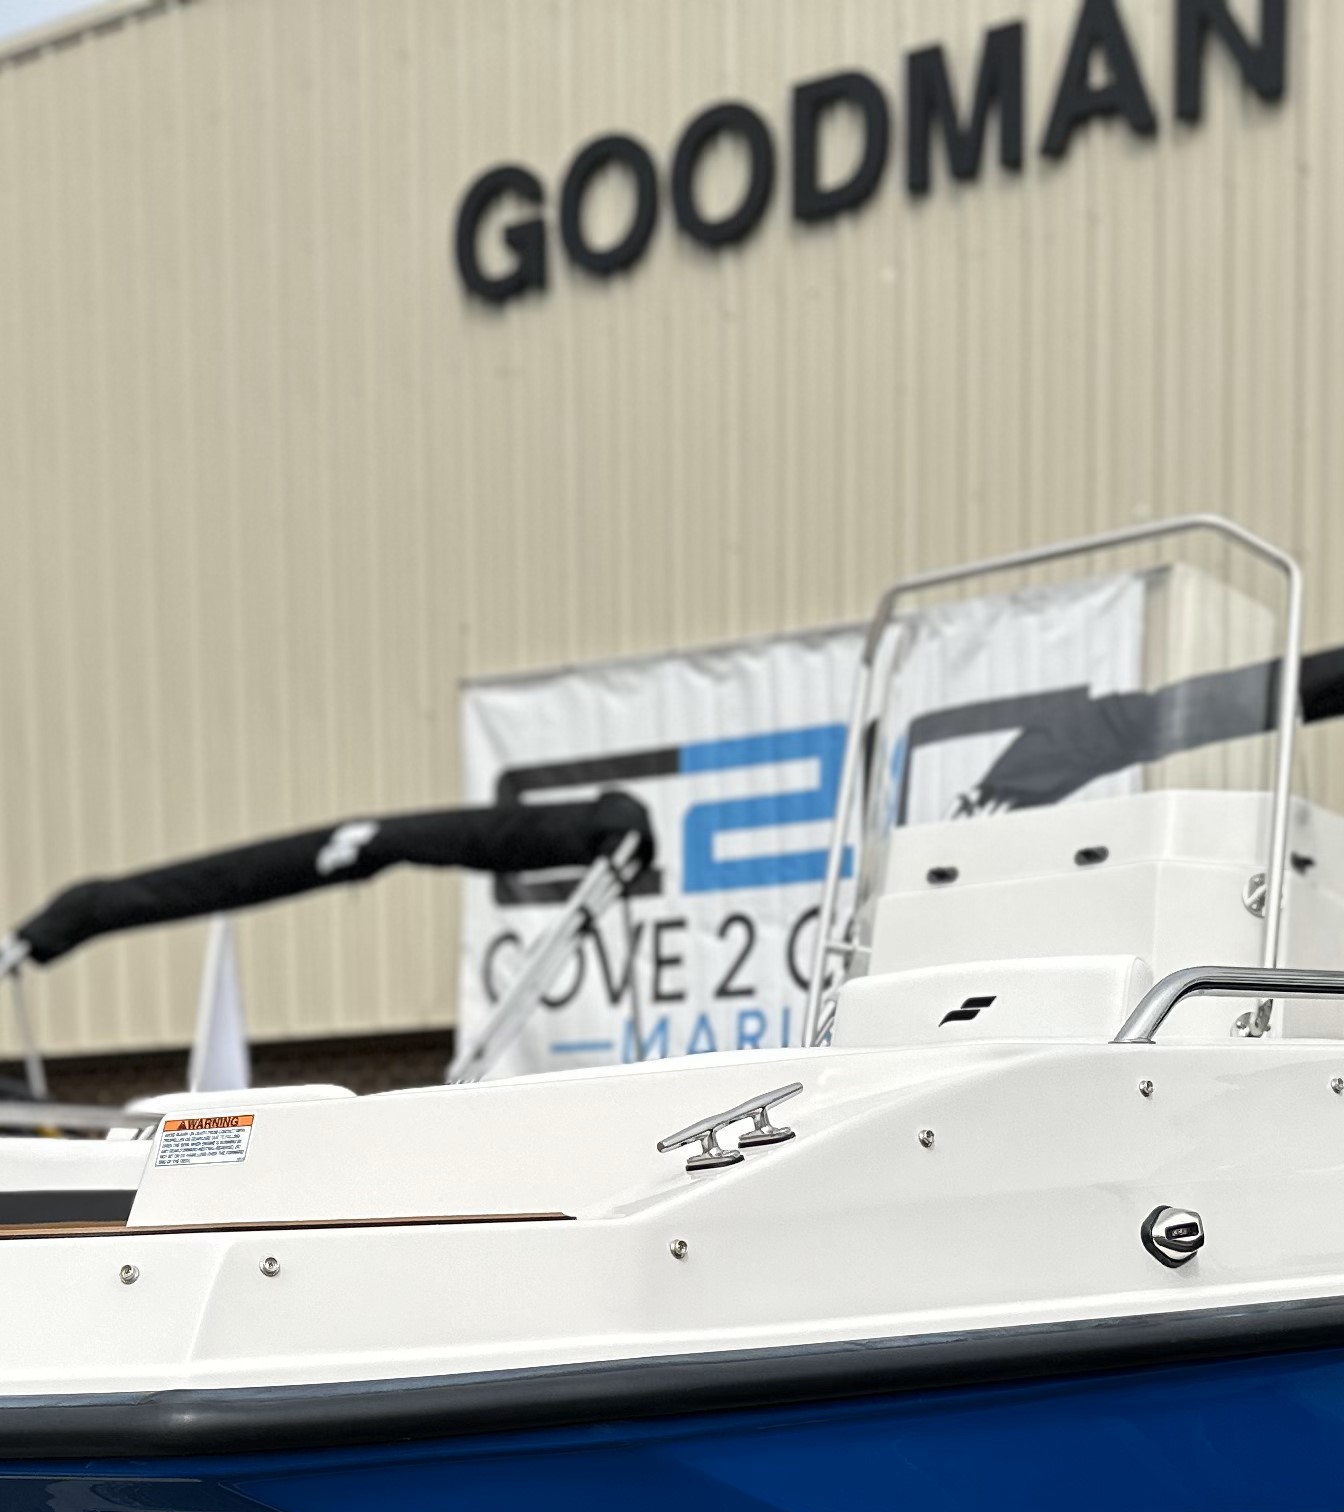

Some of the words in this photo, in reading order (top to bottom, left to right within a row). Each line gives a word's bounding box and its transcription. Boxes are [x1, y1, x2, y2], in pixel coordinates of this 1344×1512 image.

[453, 0, 1290, 312] GOODMAN
[482, 914, 687, 1010] COVE
[714, 911, 757, 1000] 2
[188, 1118, 239, 1129] WARNING
